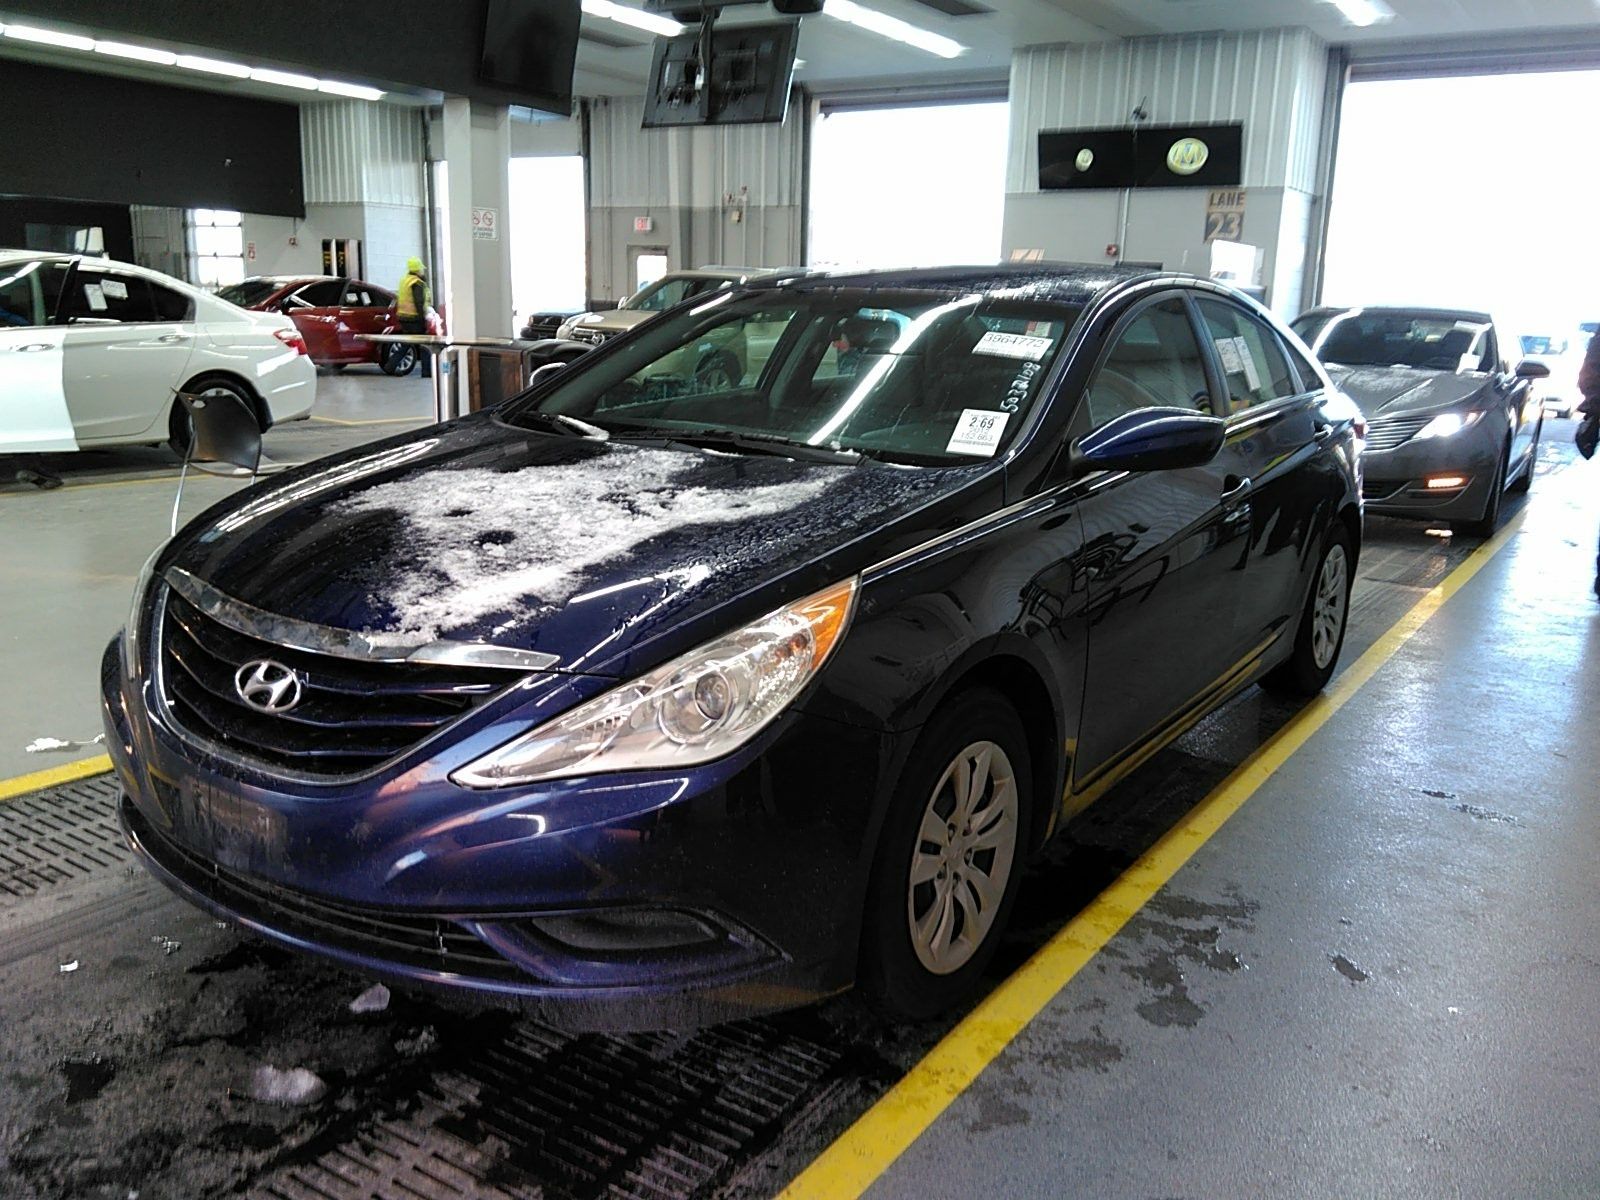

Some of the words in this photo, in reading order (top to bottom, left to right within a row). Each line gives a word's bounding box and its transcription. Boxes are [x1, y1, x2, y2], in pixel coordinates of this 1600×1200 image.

[1209, 192, 1246, 207] LANE
[1207, 212, 1241, 240] 23
[983, 333, 1045, 348] 3964772
